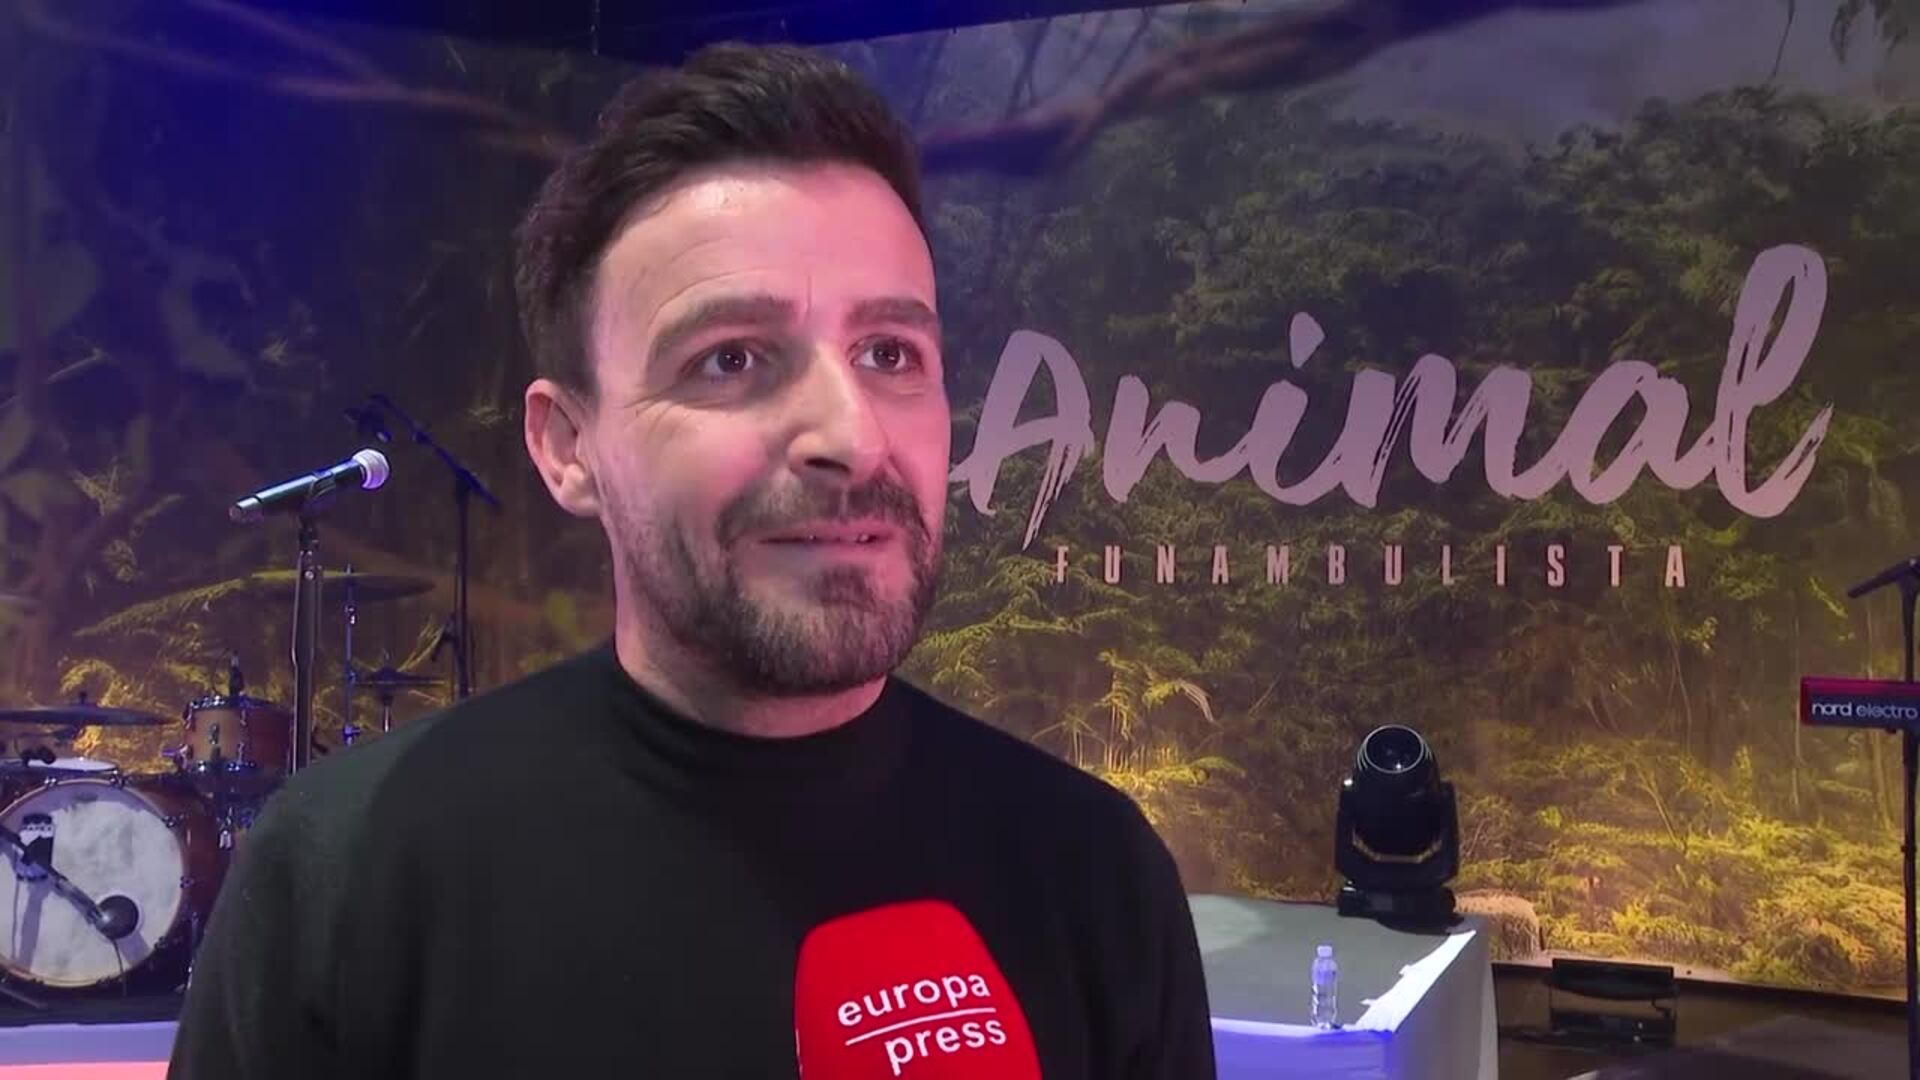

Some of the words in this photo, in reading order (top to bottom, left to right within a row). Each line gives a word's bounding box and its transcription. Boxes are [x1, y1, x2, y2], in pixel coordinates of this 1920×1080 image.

[949, 243, 1834, 550] Animal
[1057, 545, 1685, 588] FUNAMBULISTA
[1812, 702, 1852, 716] nord
[1856, 704, 1918, 719] electro
[837, 974, 991, 1026] europa
[885, 1020, 1006, 1076] press
